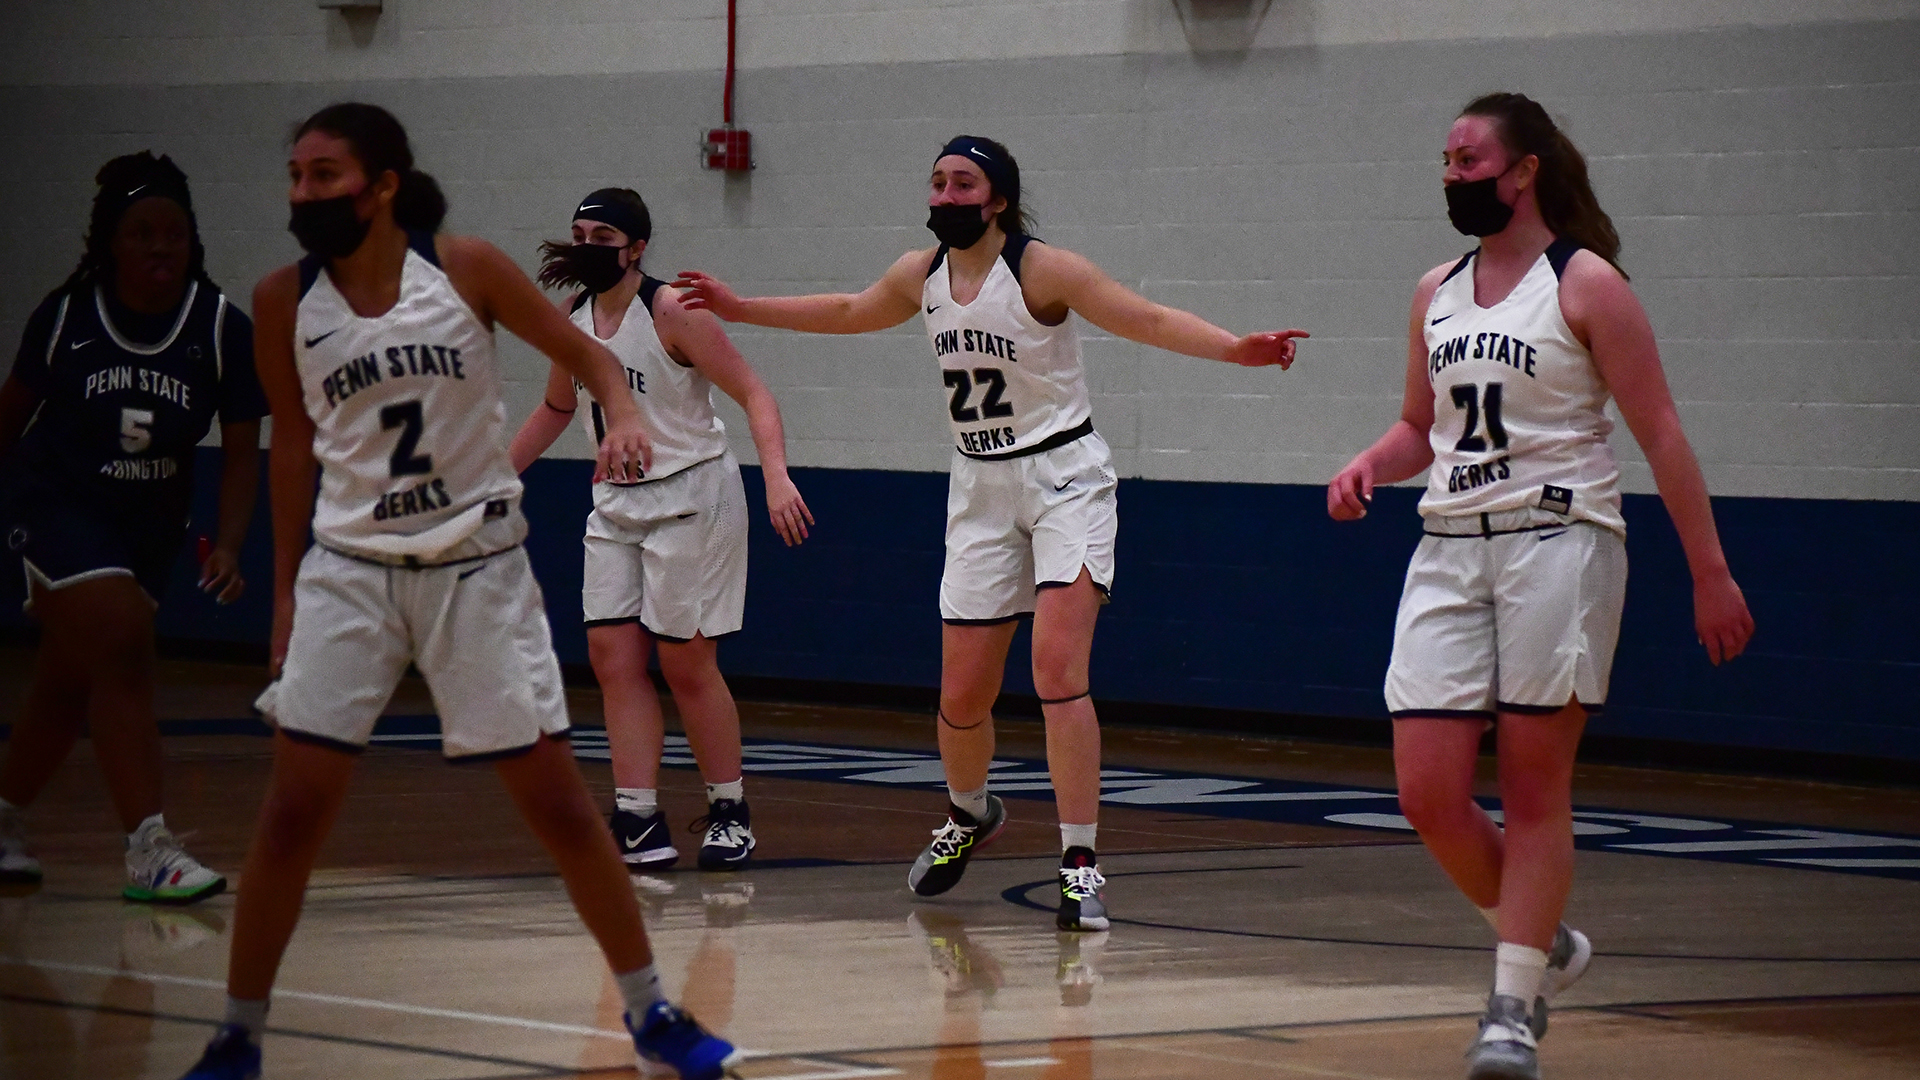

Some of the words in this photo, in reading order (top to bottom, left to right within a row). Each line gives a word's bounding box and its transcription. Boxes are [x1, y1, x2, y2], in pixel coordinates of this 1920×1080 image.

[935, 329, 958, 357] ENN
[963, 328, 1018, 363] STATE
[1473, 332, 1537, 378] STATE
[85, 366, 132, 400] PENN
[138, 368, 191, 410] STATE
[322, 352, 382, 409] PENN
[385, 344, 466, 380] STATE
[943, 367, 1014, 423] 22
[119, 407, 155, 454] 5
[380, 400, 432, 478] 2
[960, 426, 1016, 453] BERKS
[1450, 381, 1509, 452] 21
[1449, 455, 1510, 493] BERKS
